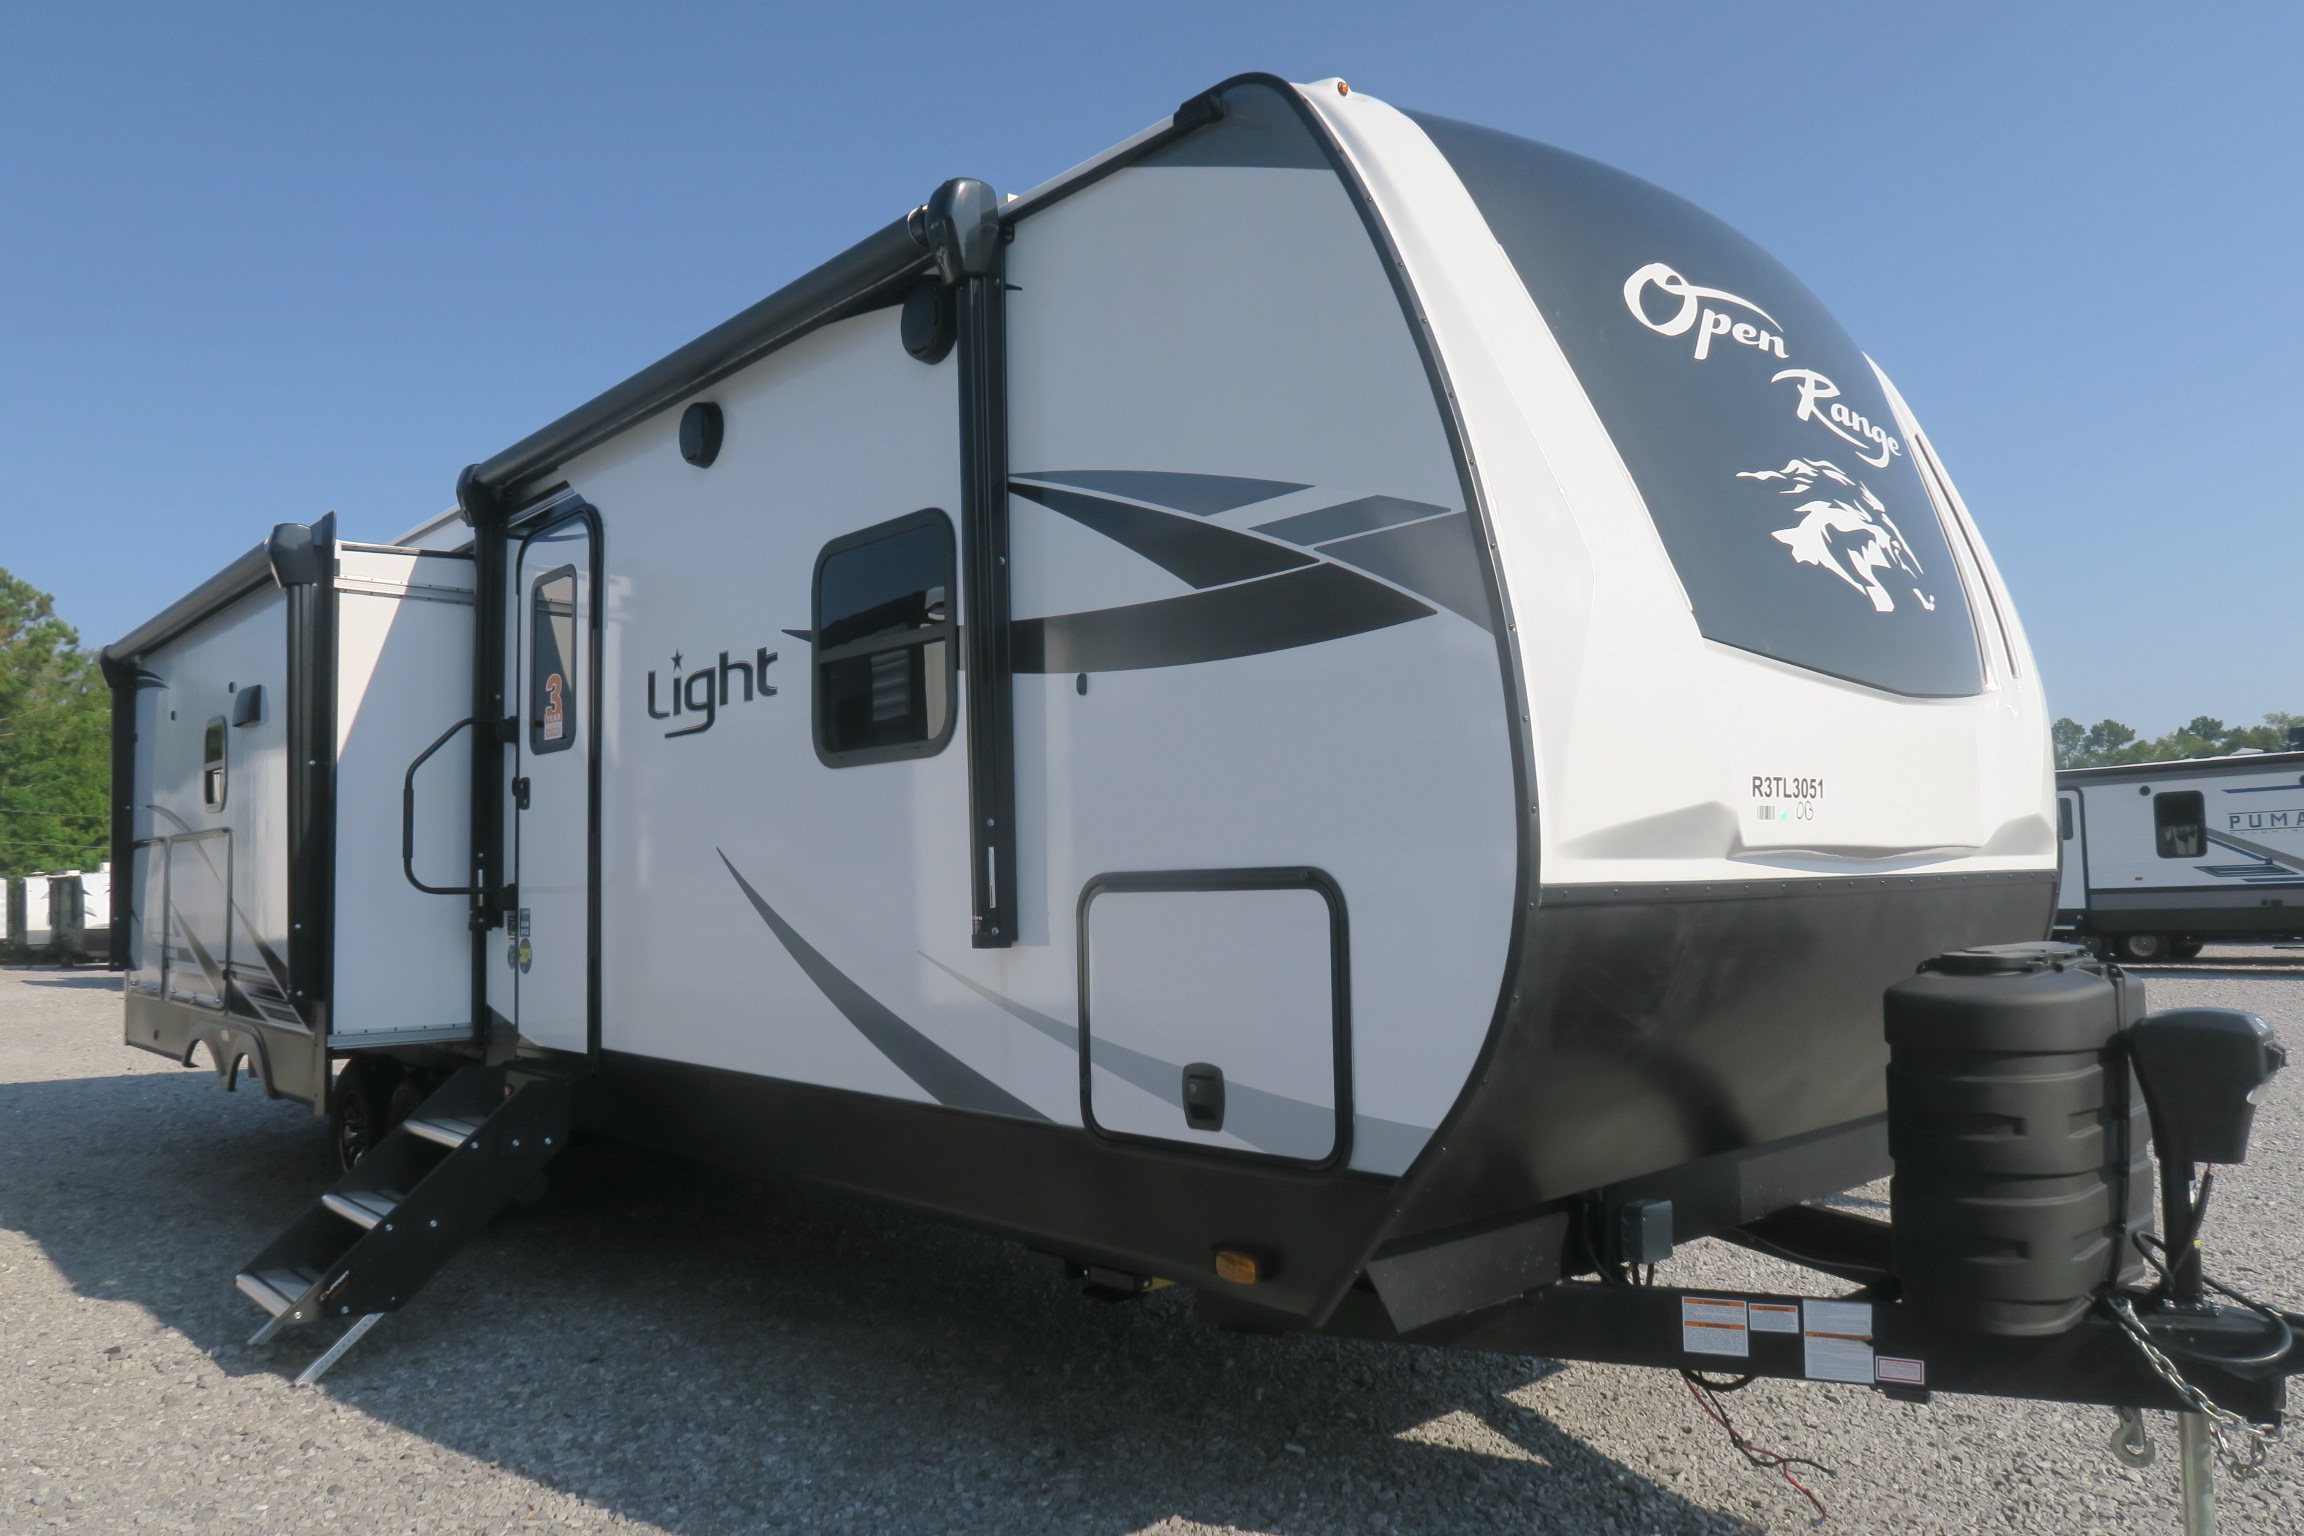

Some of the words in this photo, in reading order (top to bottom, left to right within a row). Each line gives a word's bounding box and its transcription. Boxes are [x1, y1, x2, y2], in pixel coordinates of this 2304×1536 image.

[1623, 262, 1789, 360] Open
[1771, 368, 1902, 468] Range
[545, 673, 563, 715] 3
[647, 646, 778, 739] Light
[1751, 775, 1824, 799] R3TL3051
